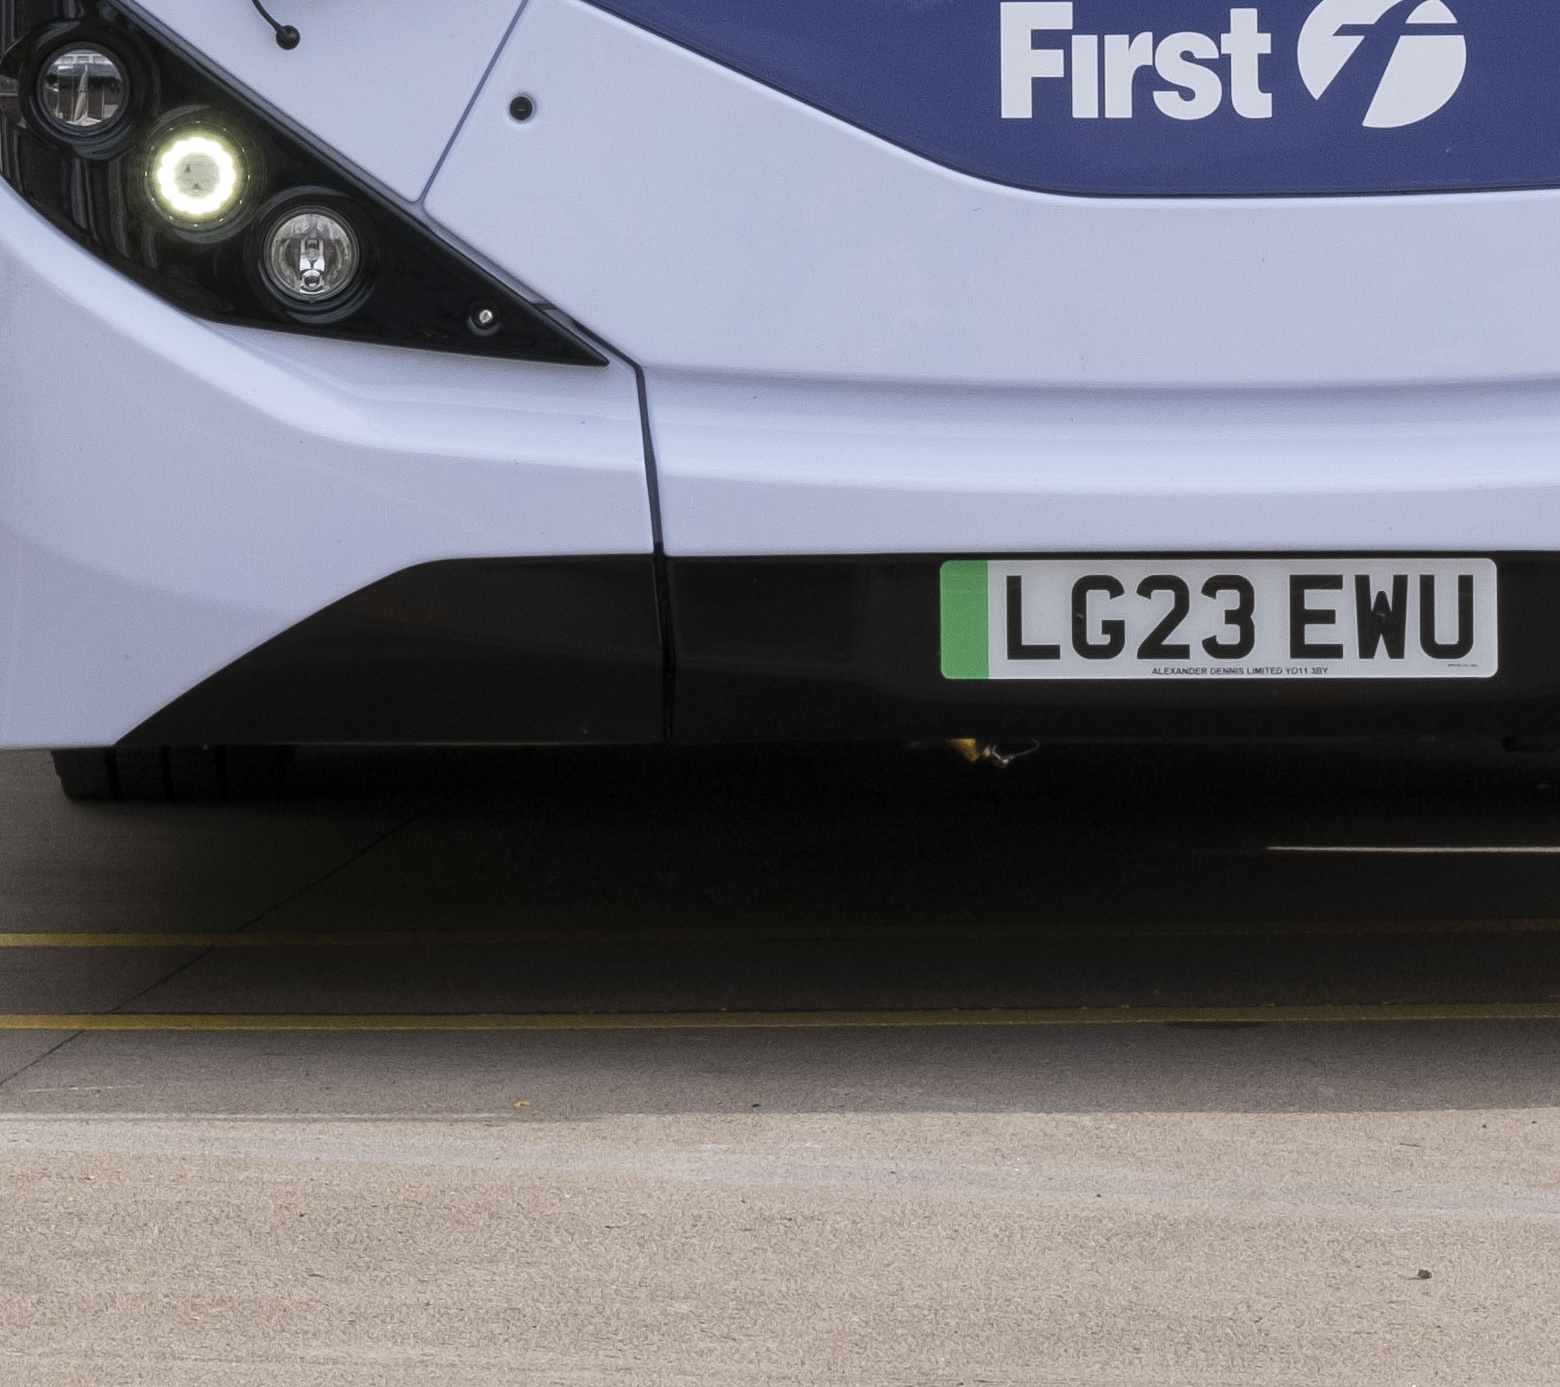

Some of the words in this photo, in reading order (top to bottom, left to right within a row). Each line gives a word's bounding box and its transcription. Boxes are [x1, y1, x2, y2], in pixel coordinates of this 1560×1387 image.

[999, 0, 1273, 121] First
[1006, 574, 1256, 662] LG23
[1288, 574, 1475, 661] EWU
[1151, 667, 1208, 676] ALEXANDER
[1209, 667, 1245, 676] DENNIS
[1246, 667, 1283, 675] LIMITED
